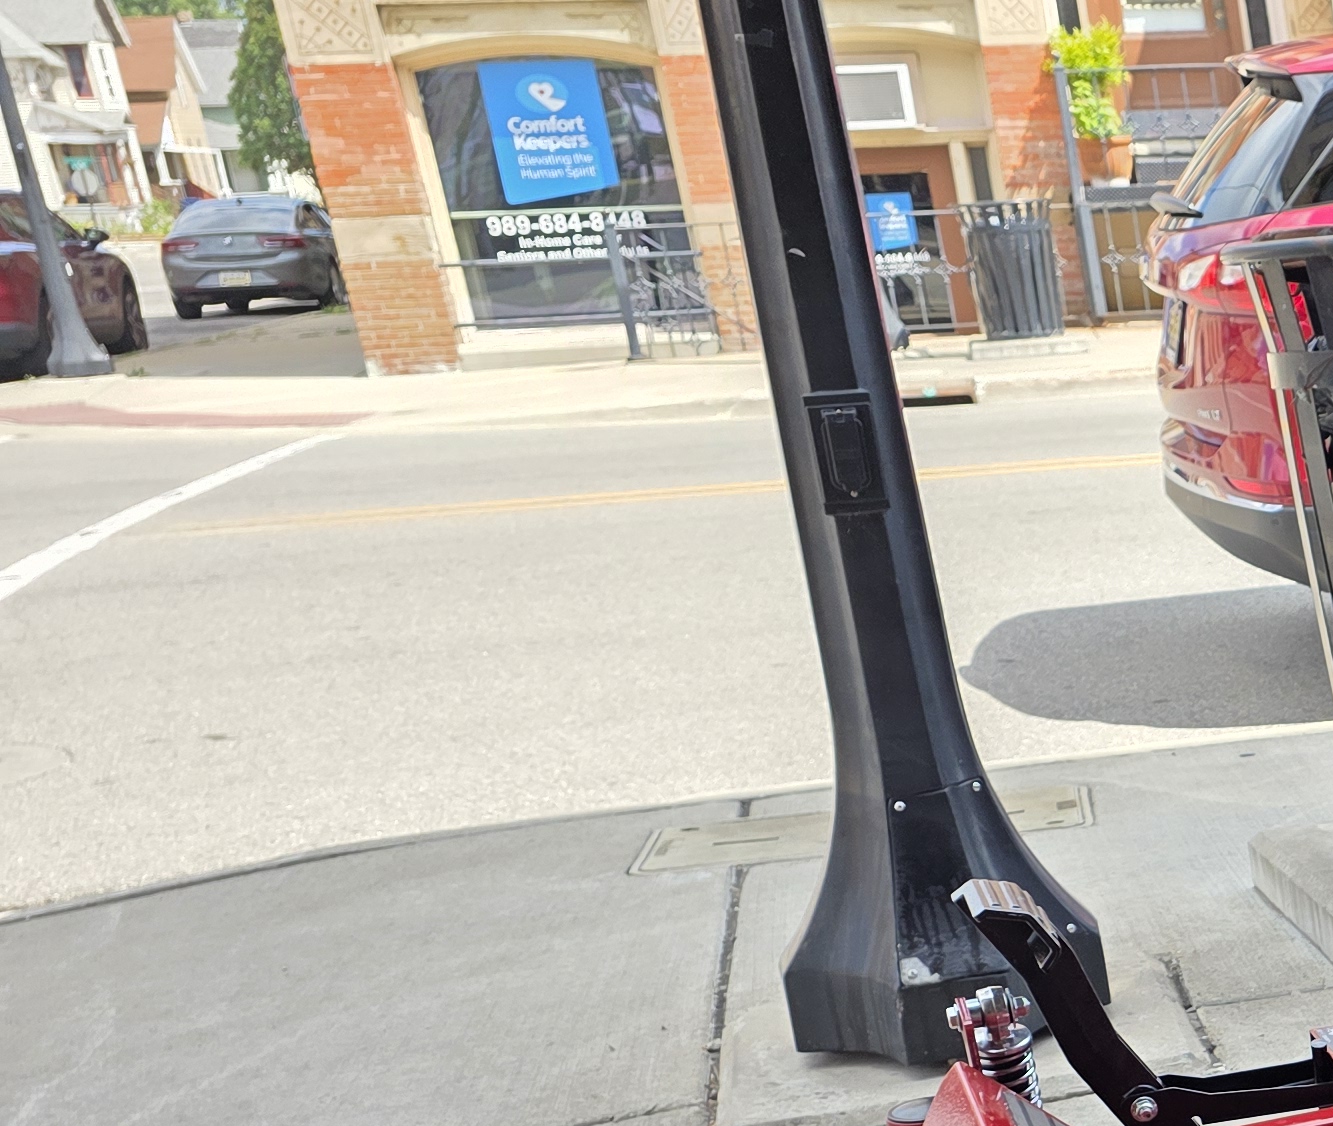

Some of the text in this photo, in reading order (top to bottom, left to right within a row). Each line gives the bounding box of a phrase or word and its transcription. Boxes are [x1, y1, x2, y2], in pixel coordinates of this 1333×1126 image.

[507, 115, 586, 134] Comfort
[512, 133, 590, 152] Keepers
[518, 153, 594, 167] Elevating the
[518, 234, 603, 249] In-Home Care
[497, 250, 546, 263] Seniors
